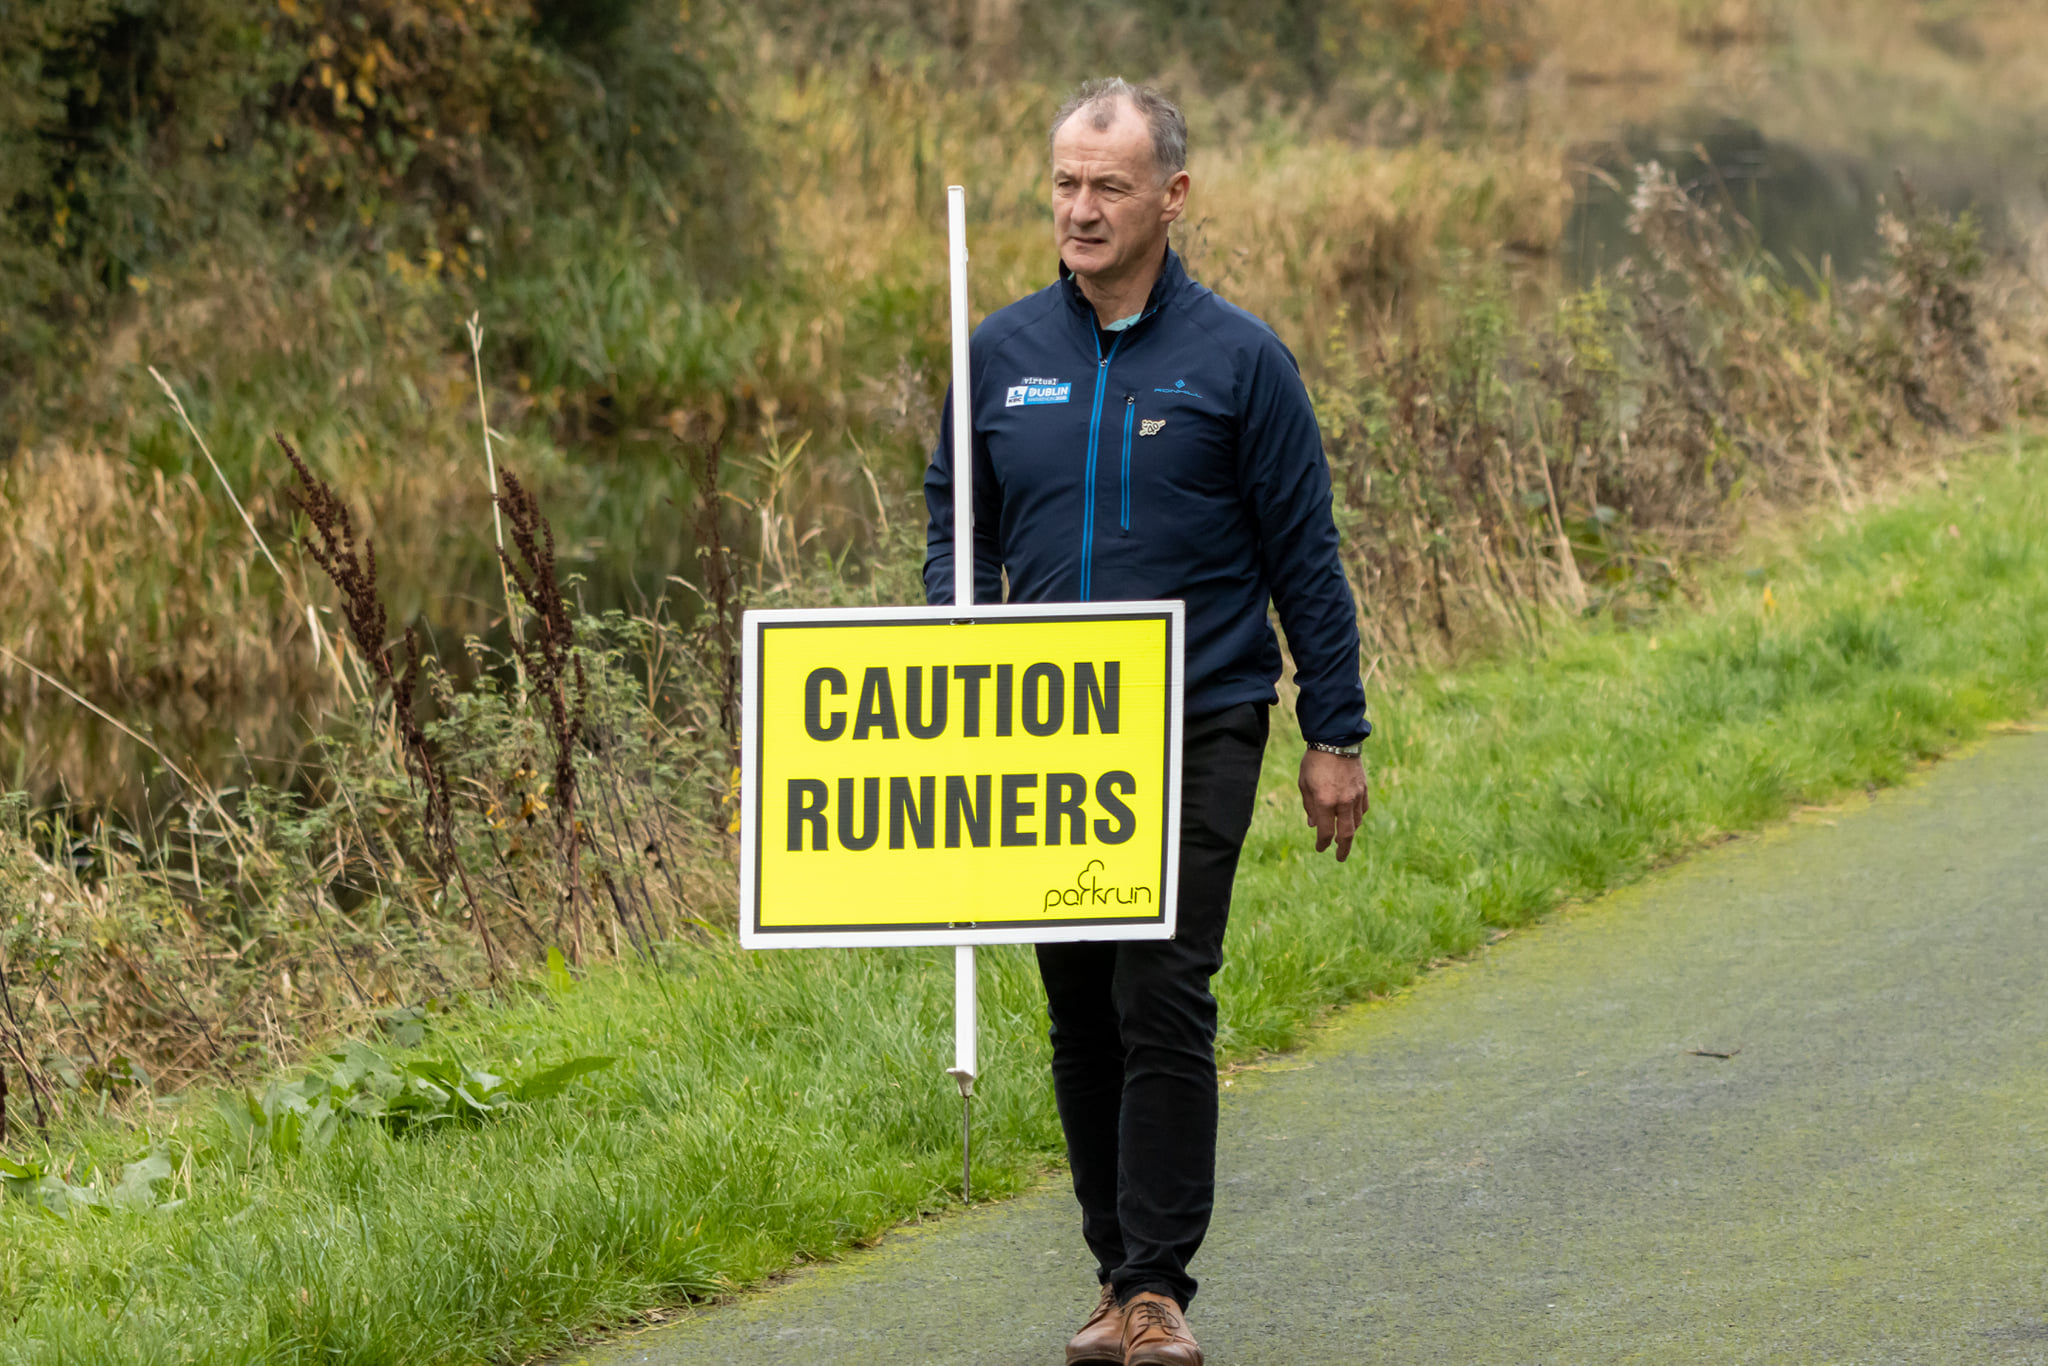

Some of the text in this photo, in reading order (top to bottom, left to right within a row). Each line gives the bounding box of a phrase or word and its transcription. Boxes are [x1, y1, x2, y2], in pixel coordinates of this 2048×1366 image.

[1023, 377, 1057, 386] virtual
[1028, 386, 1069, 397] DUBLIN
[804, 661, 1121, 742] CAUTION
[787, 770, 1137, 852] RUNNERS
[1043, 864, 1152, 913] parkrun
